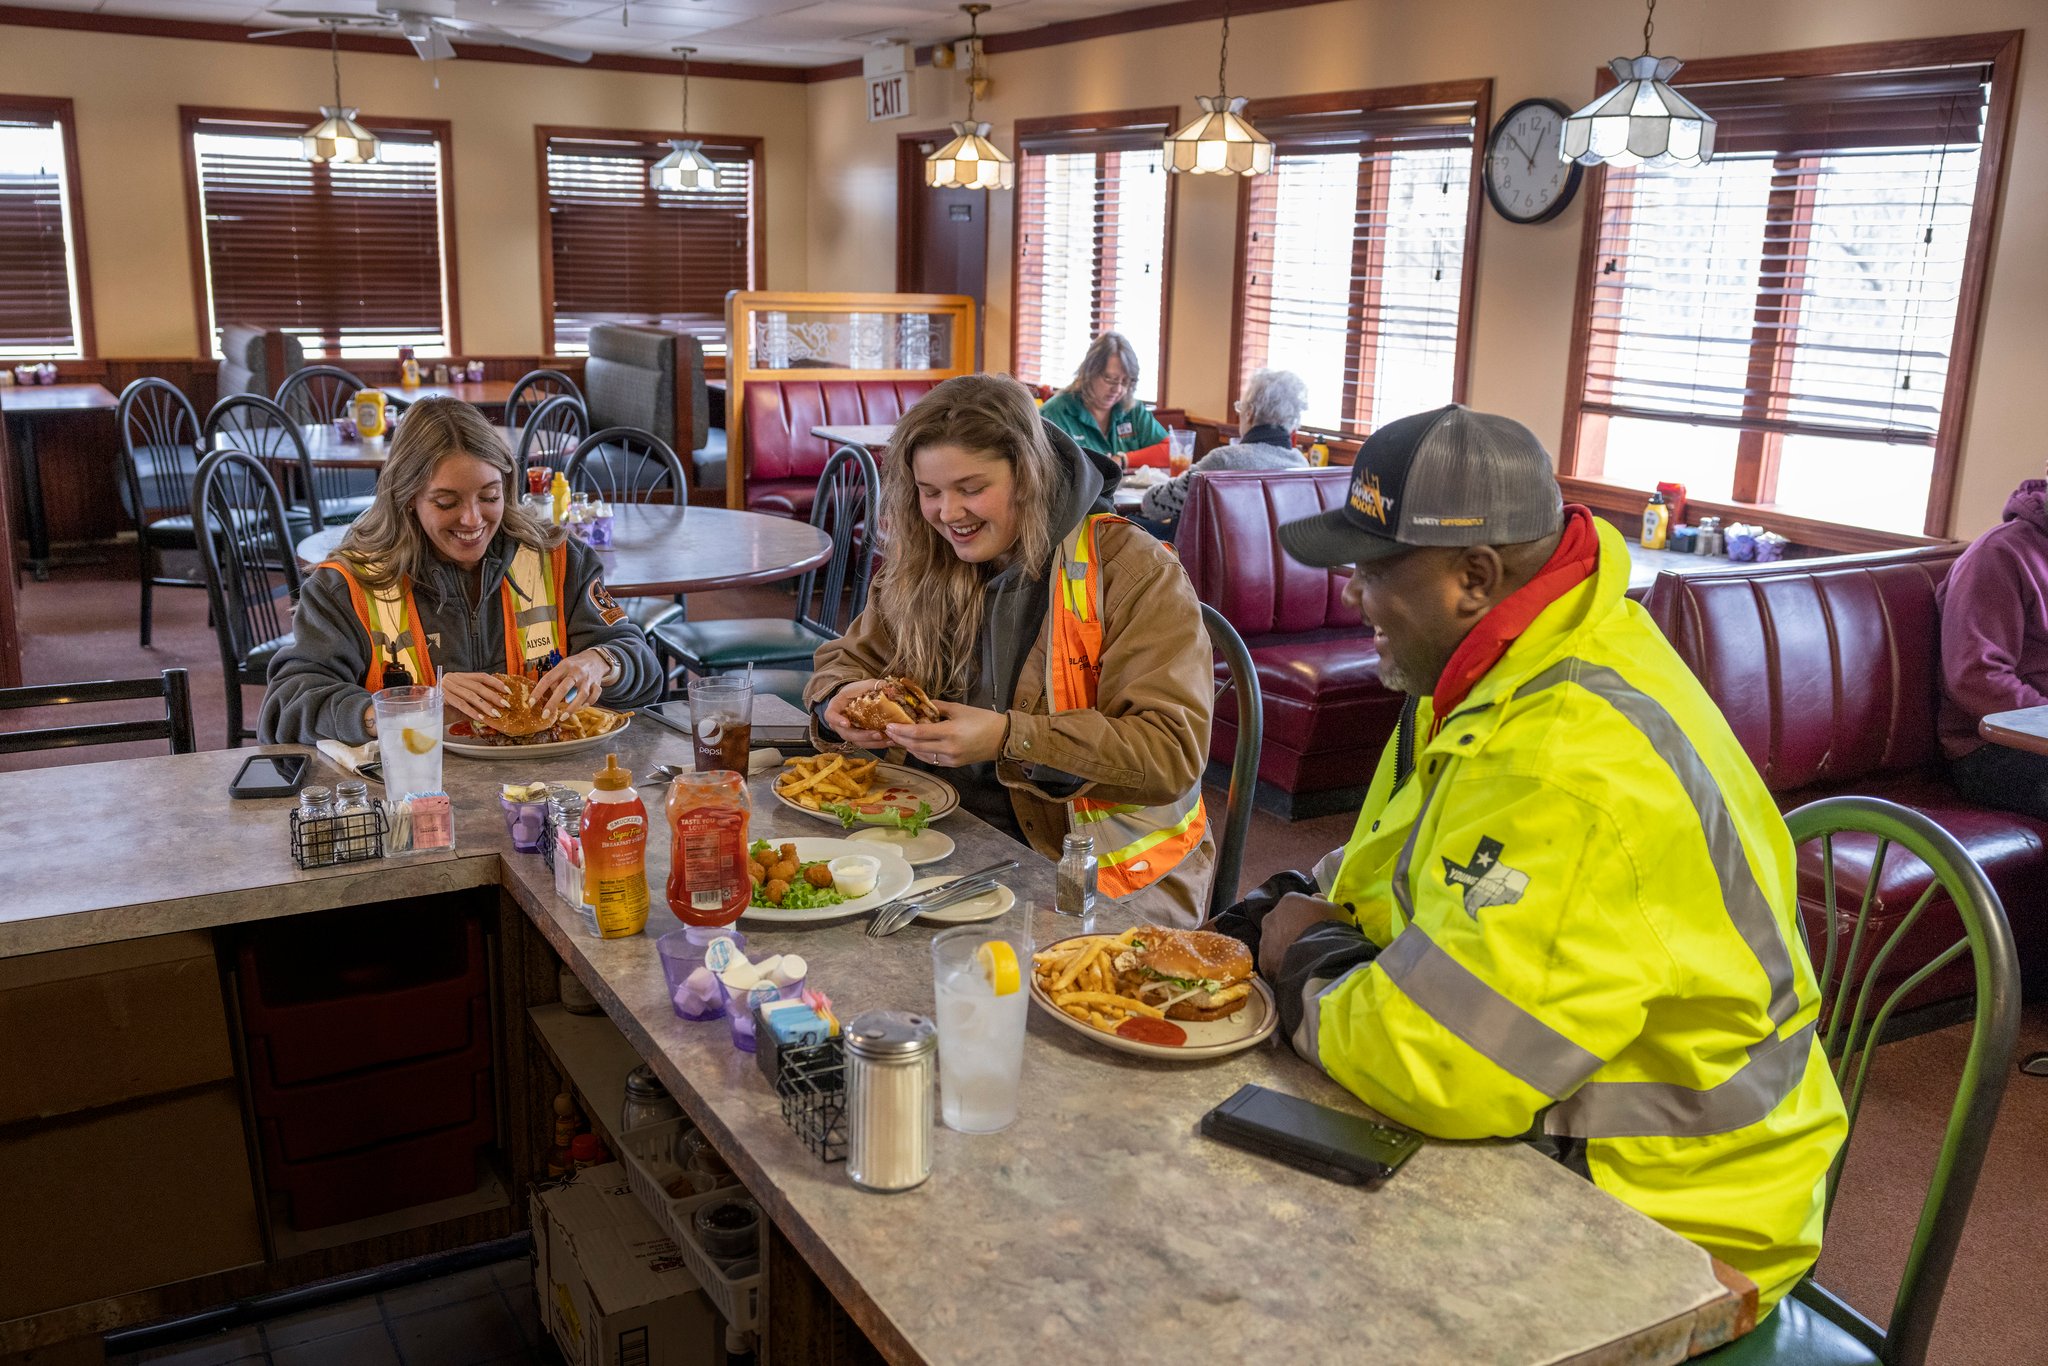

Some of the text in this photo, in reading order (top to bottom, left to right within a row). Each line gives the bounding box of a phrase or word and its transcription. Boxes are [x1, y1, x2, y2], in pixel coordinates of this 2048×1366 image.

[872, 78, 902, 117] EXIT
[1518, 122, 1526, 136] 11
[1531, 116, 1542, 131] 12
[1501, 157, 1510, 170] 9
[1503, 175, 1512, 189] 8
[1551, 174, 1559, 187] 4
[1512, 189, 1520, 203] 7
[1524, 193, 1534, 207] 6
[1540, 189, 1549, 203] 5
[526, 636, 552, 649] ALYSSA
[699, 746, 723, 756] pepsi
[702, 817, 716, 825] YOU
